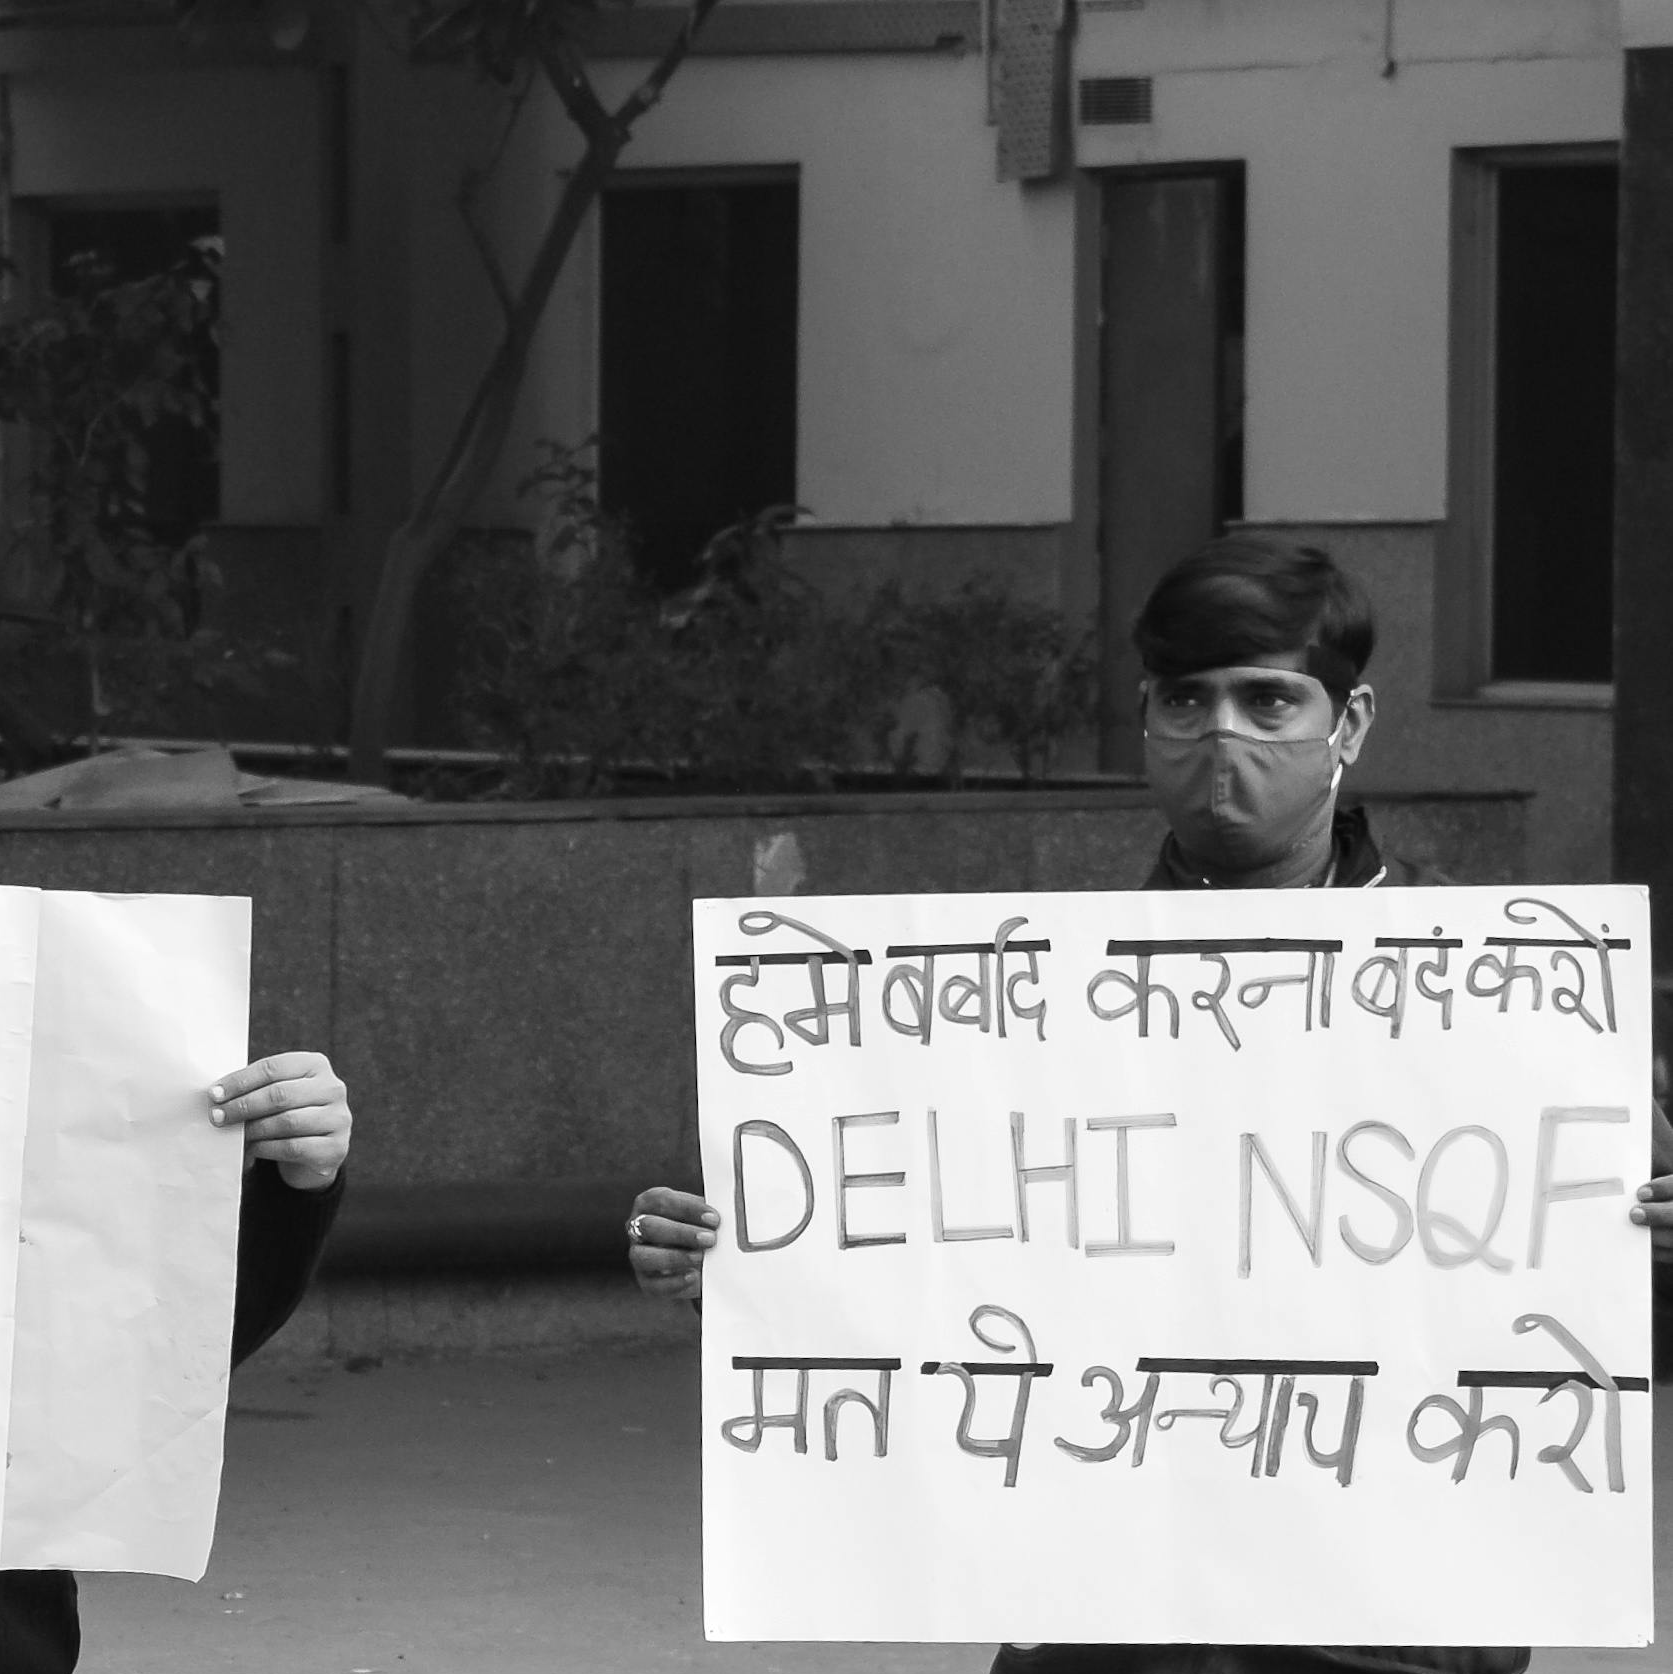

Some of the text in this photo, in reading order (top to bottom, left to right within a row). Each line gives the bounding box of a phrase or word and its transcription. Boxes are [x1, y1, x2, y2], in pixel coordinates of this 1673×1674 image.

[1086, 936, 1344, 1052] करना
[733, 1105, 1630, 1280] DELHI NSQF
[721, 1355, 903, 1463] मत
